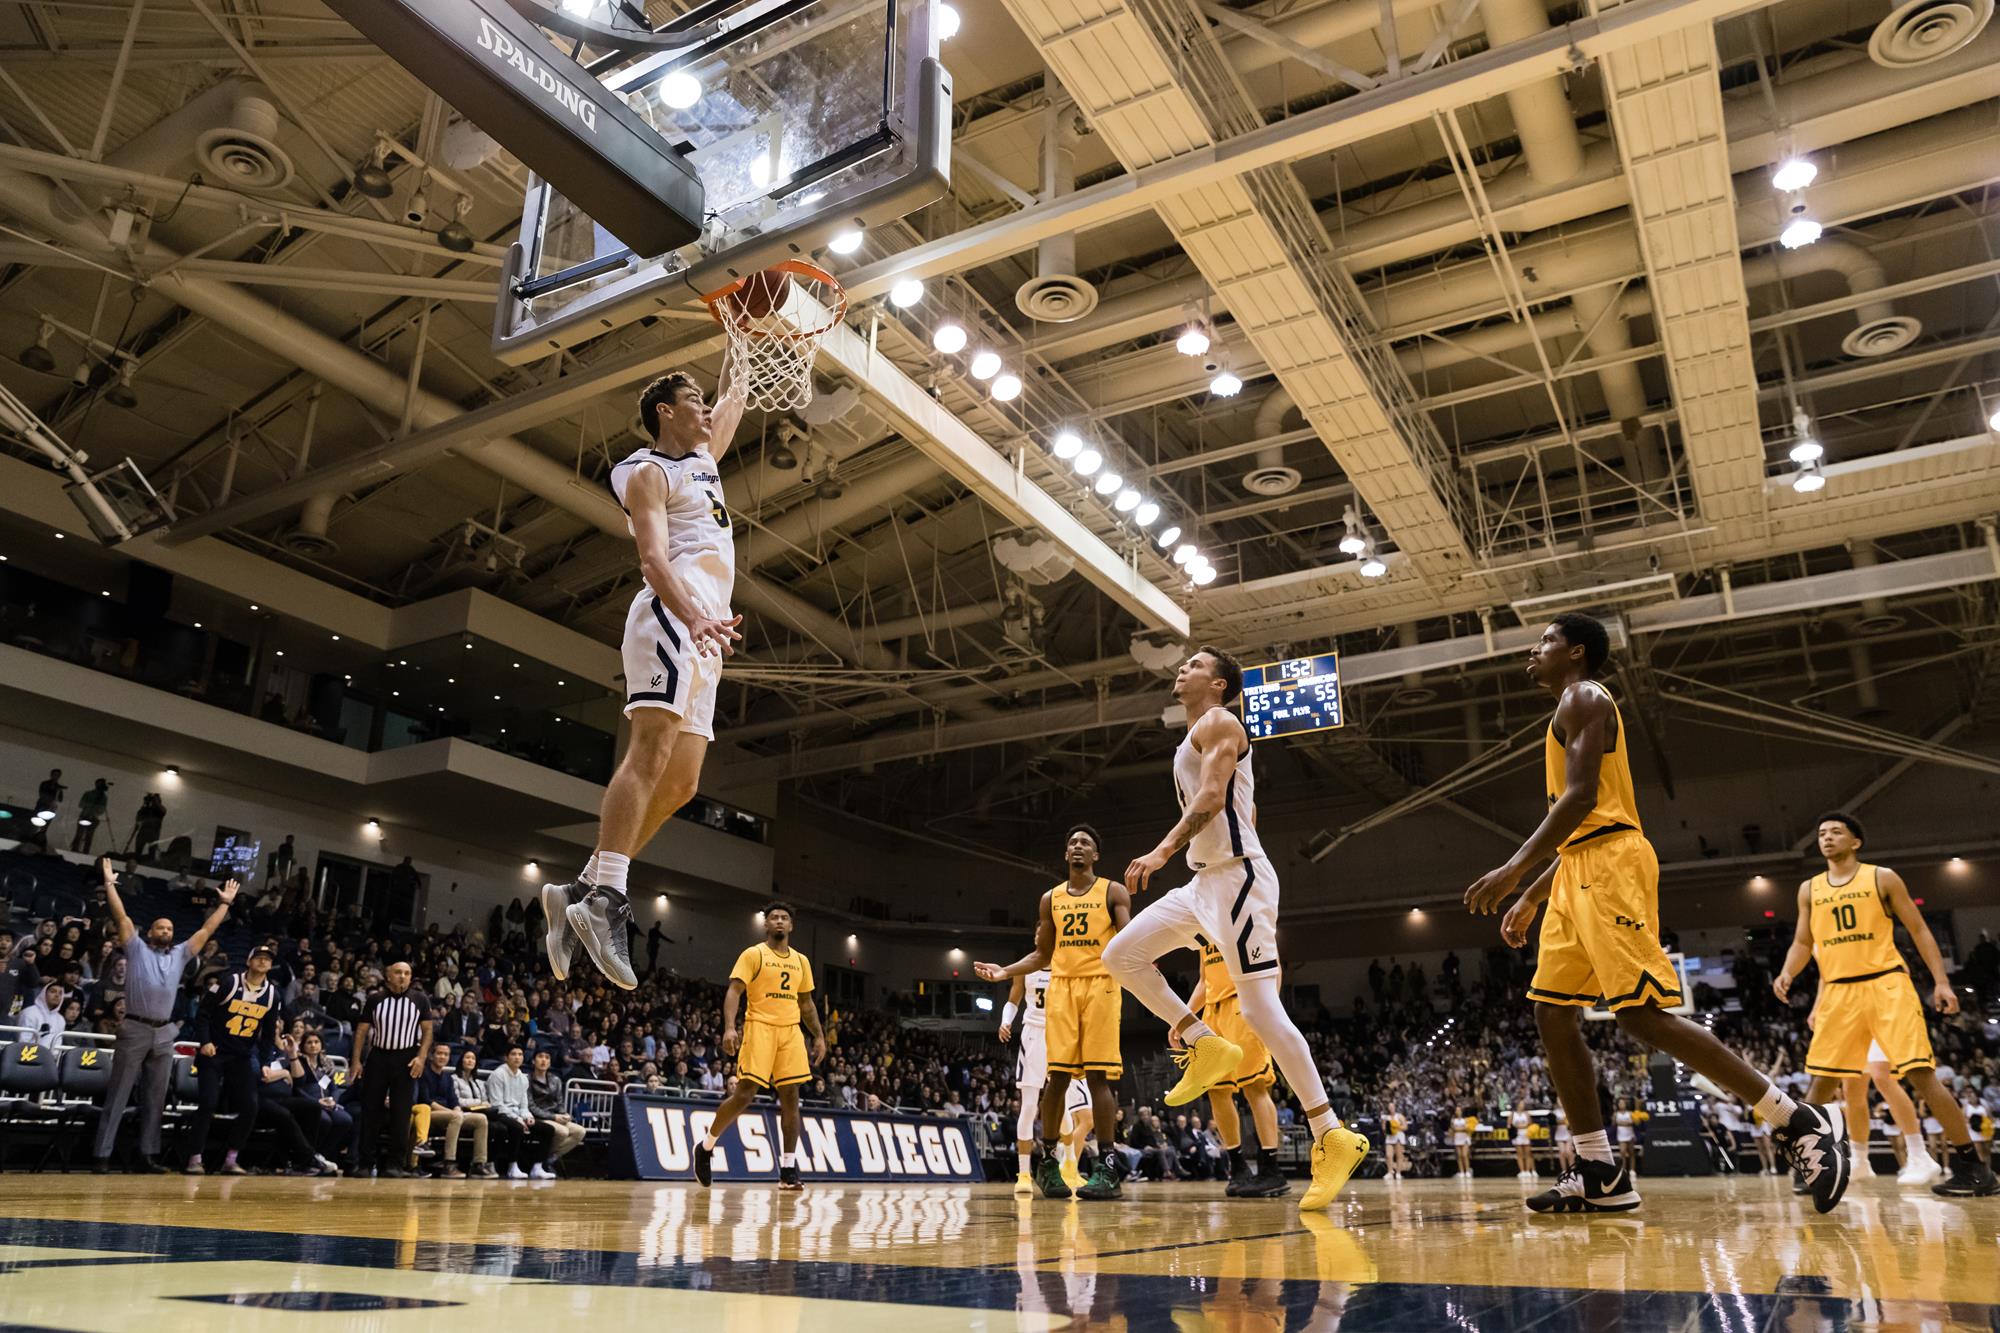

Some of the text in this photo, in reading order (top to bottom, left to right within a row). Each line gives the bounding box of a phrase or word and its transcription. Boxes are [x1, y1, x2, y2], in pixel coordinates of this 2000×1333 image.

[477, 17, 597, 134] SPALDING
[704, 489, 730, 528] 5
[1281, 659, 1311, 678] 1:52
[1249, 694, 1271, 712] 65
[1285, 691, 1295, 705] 2
[1314, 682, 1337, 702] 55
[1330, 711, 1339, 724] 7
[1250, 725, 1260, 736] 4
[1815, 890, 1871, 906] CAL POLY
[1062, 912, 1089, 936] 23
[1831, 904, 1857, 932] 10
[1823, 932, 1875, 947] POMONA
[780, 971, 791, 991] 2
[225, 1014, 259, 1038] 42
[850, 1119, 973, 1177] DIEGO
